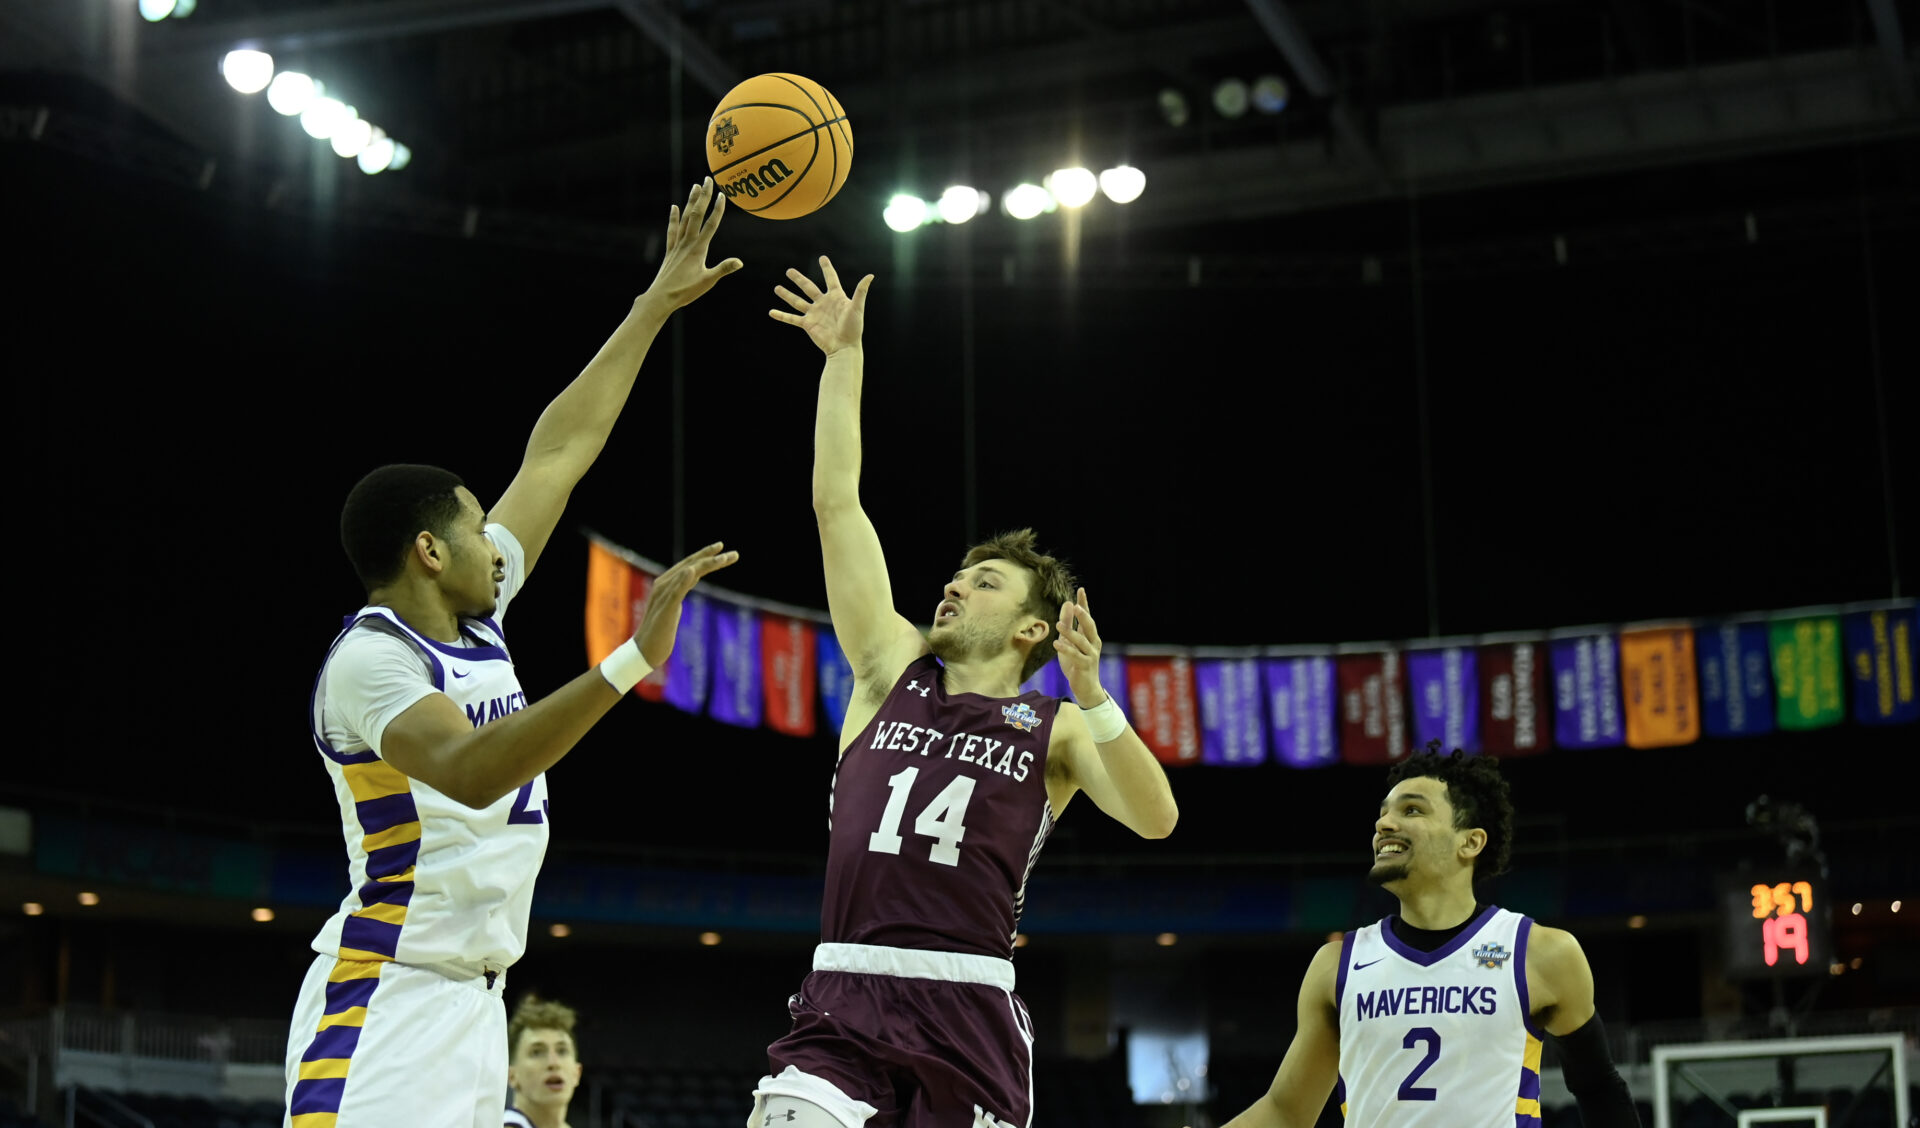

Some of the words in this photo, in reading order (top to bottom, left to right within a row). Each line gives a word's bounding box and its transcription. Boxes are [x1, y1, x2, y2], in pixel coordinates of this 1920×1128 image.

[870, 721, 944, 756] WEST
[945, 733, 1034, 782] TEXAS
[507, 779, 549, 825] 2
[868, 766, 977, 867] 14
[1763, 913, 1809, 966] 19
[1357, 986, 1497, 1022] MAVERICKS
[1397, 1027, 1441, 1101] 2
